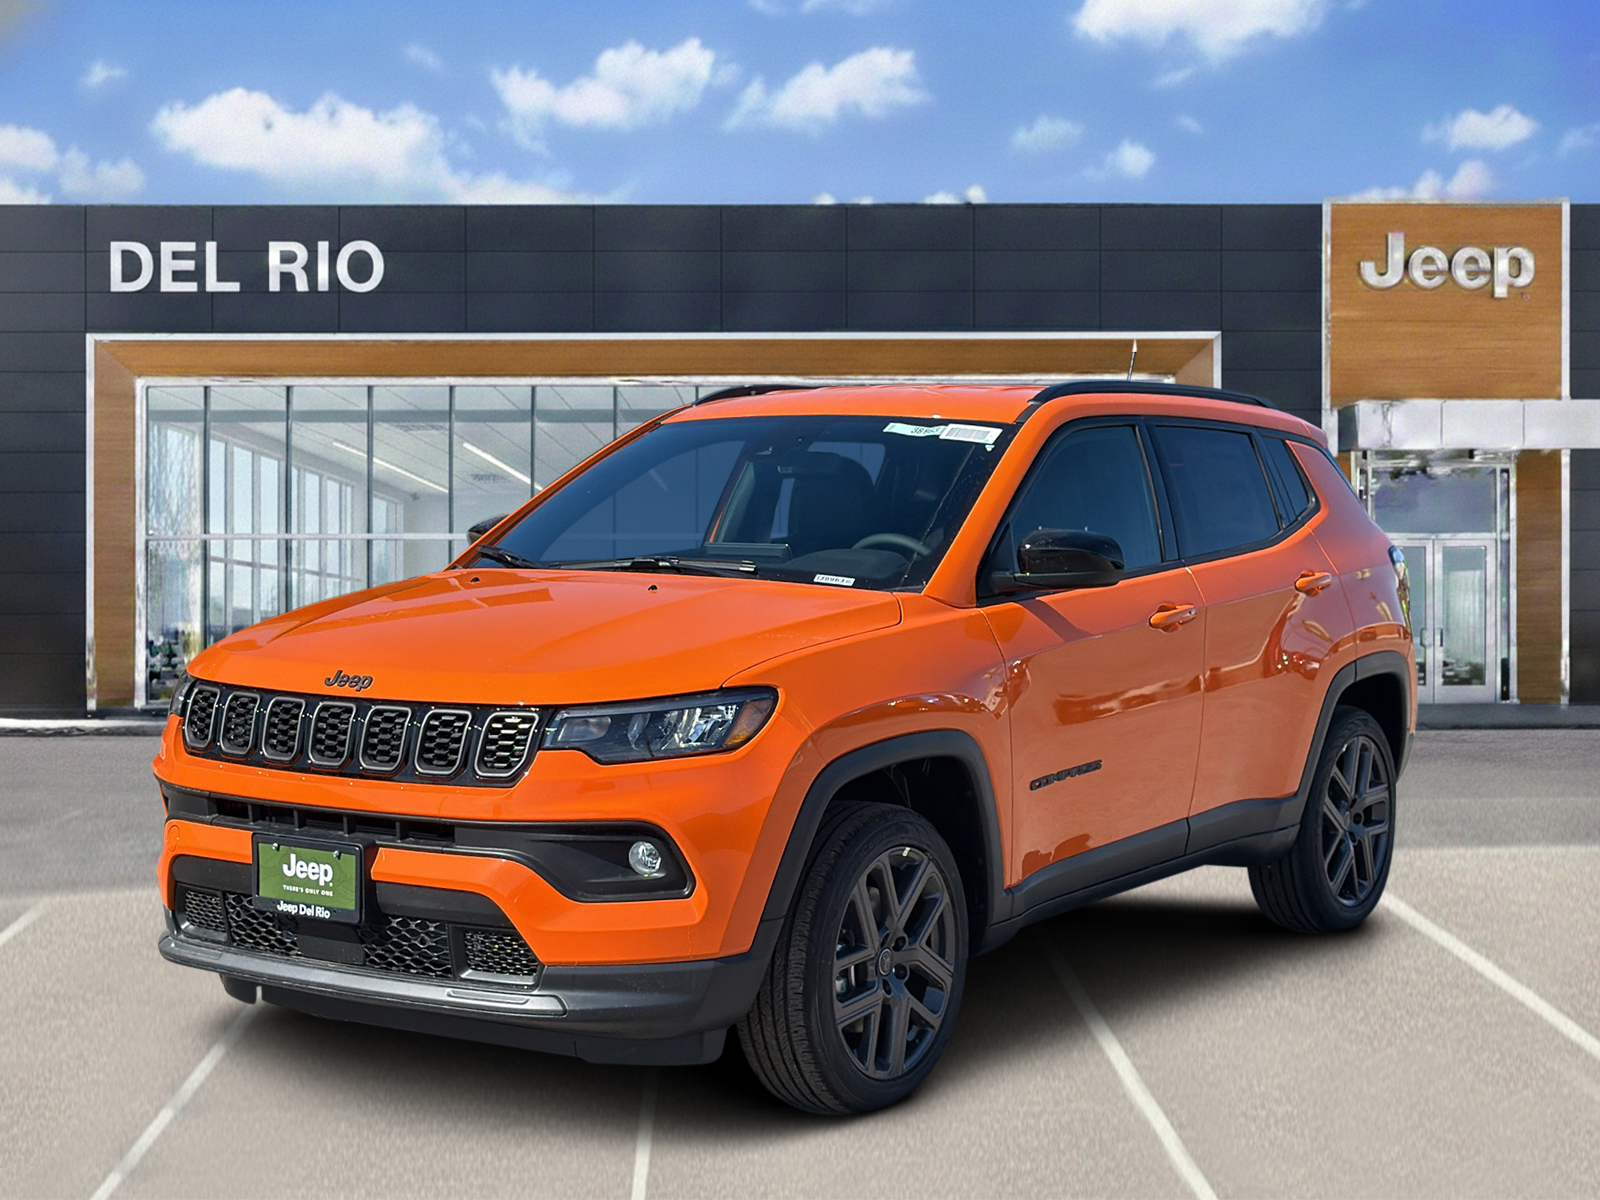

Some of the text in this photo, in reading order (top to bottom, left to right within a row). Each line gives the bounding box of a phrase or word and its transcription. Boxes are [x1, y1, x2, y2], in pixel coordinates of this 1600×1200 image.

[109, 239, 385, 294] DEL RIO
[1359, 231, 1536, 299] Jeep
[324, 669, 374, 693] Jeep
[1029, 759, 1102, 791] COMPASS
[282, 853, 333, 887] Jeep
[305, 887, 319, 895] ONLY
[321, 889, 333, 897] ONE
[276, 900, 331, 919] Jeep Del Rio
